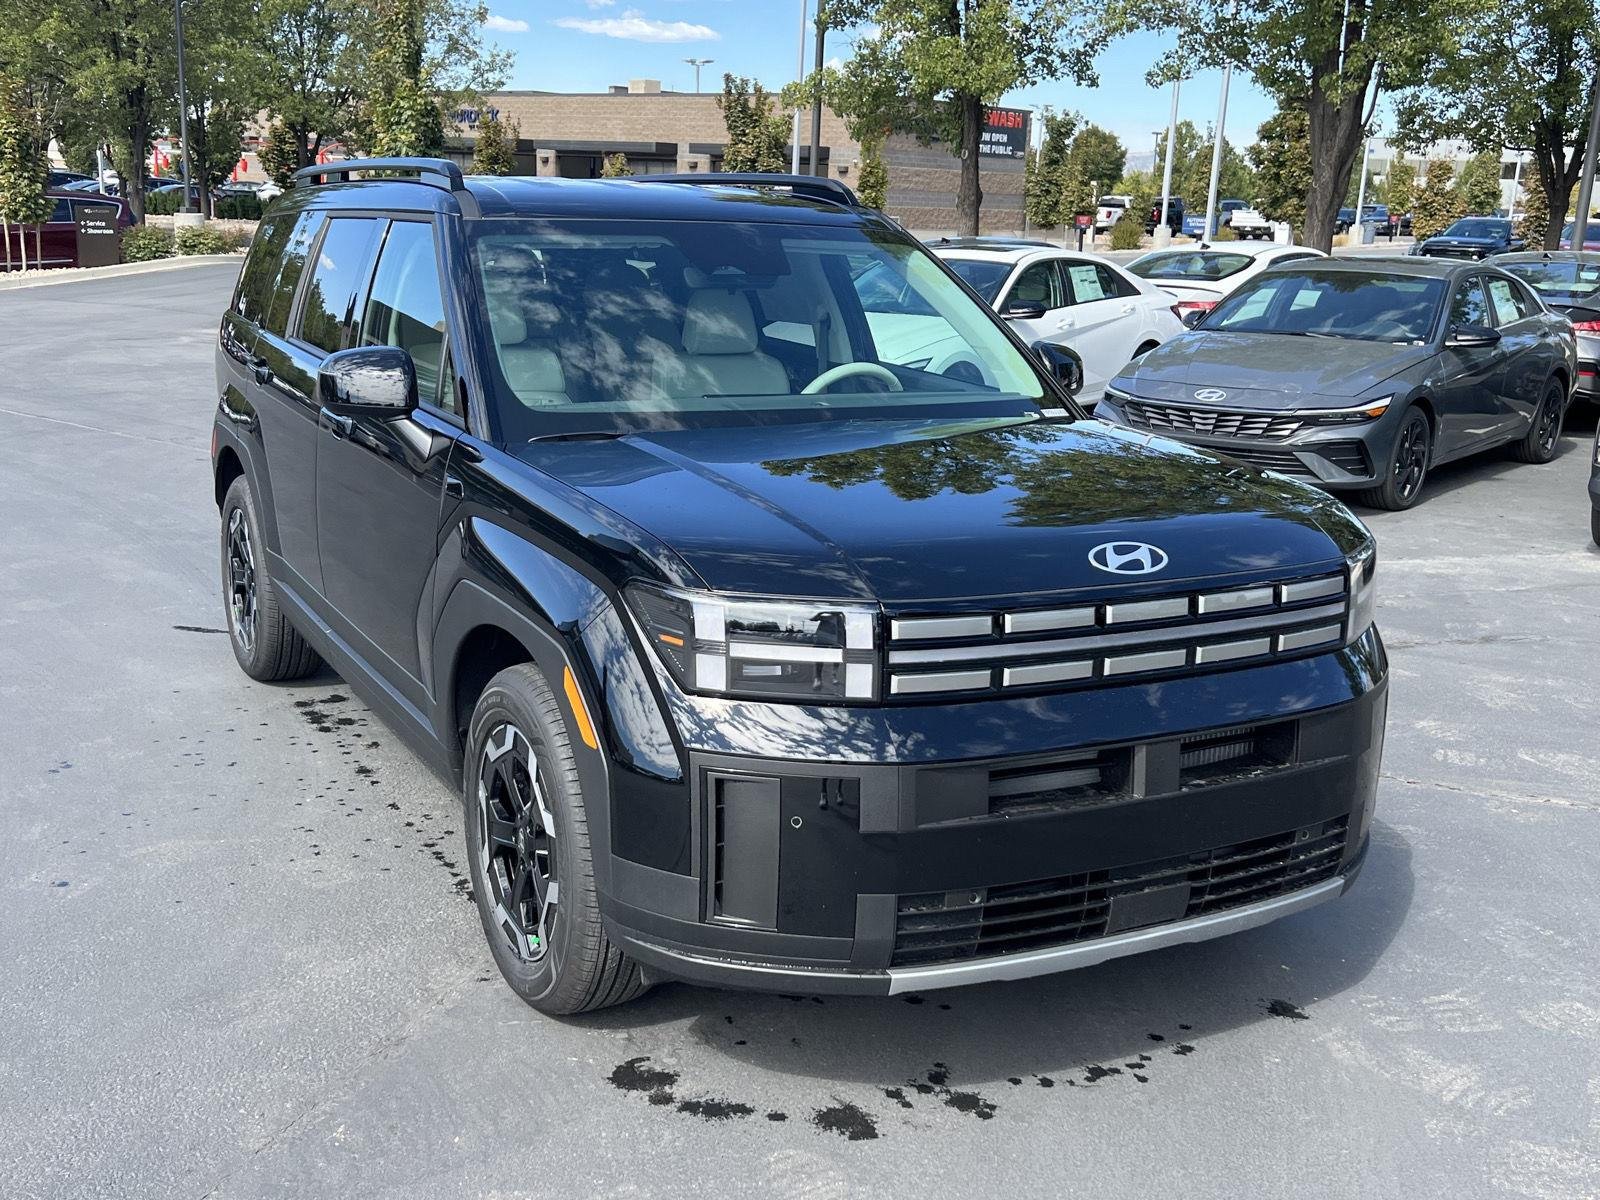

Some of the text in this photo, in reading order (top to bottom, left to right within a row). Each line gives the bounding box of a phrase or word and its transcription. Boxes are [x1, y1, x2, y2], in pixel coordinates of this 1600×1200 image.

[989, 110, 1022, 128] WASH
[992, 133, 1008, 142] OPEN
[979, 144, 1013, 155] THE PUBLIC
